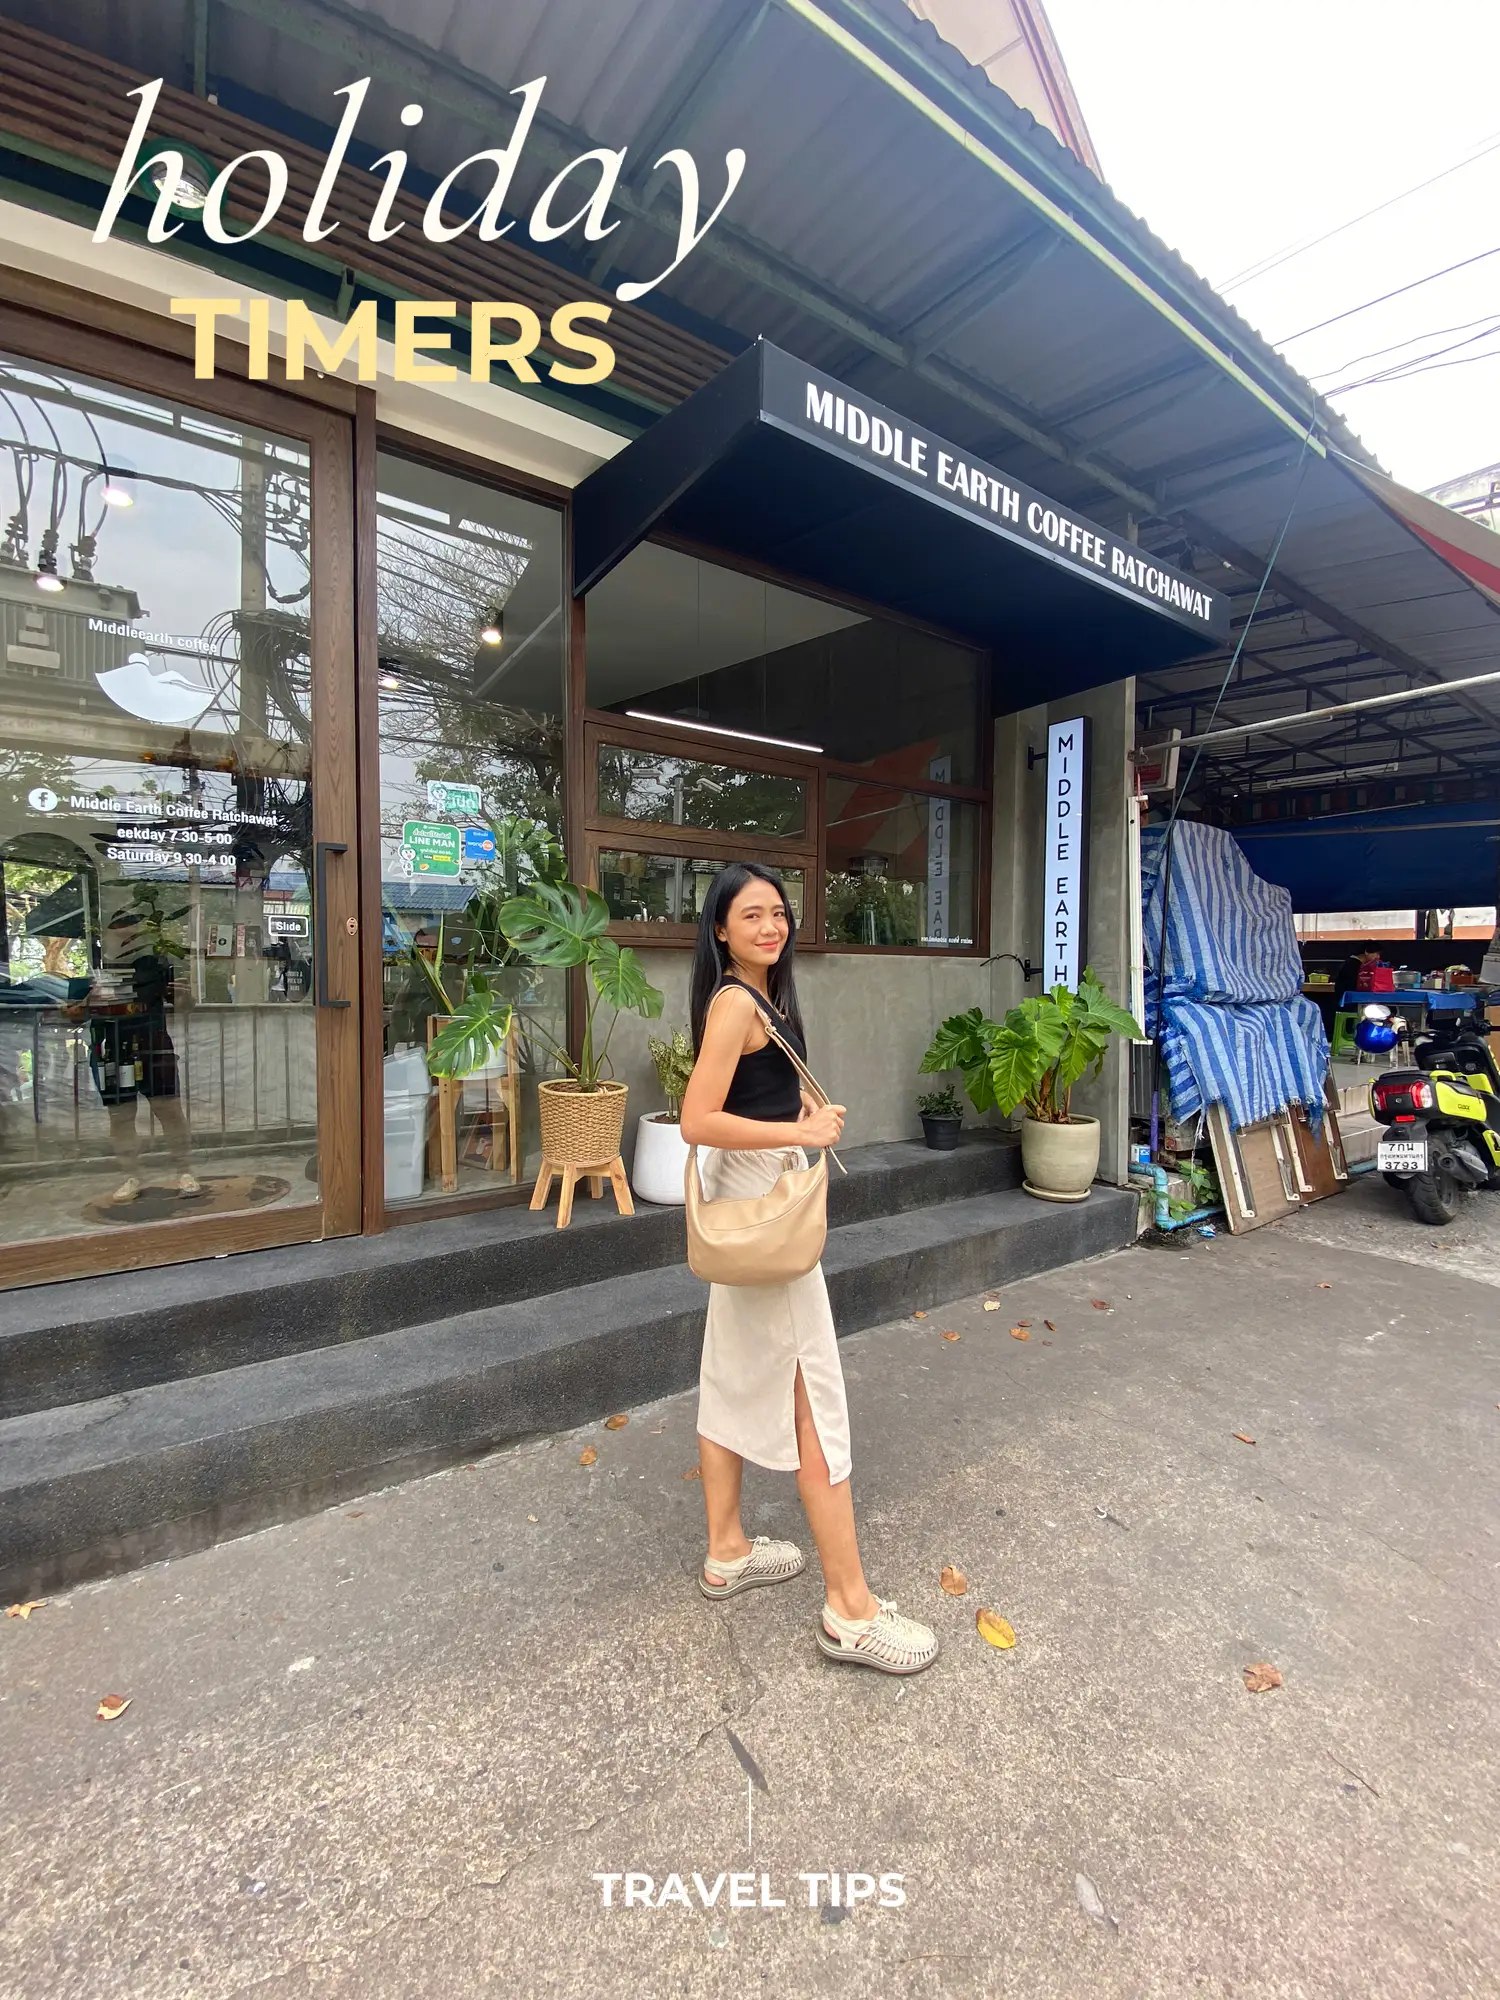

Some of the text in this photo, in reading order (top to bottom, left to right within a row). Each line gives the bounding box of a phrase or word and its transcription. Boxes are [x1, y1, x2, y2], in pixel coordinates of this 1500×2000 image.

[806, 381, 1213, 621] MIDDLE EARTH COFFEE RATCHAWAT
[88, 618, 218, 653] Middleearth coffee
[70, 795, 121, 812] Middle
[126, 801, 162, 816] Earth
[166, 804, 209, 819] Coffee
[213, 809, 278, 826] Ratchawat
[409, 836, 456, 848] LINE MAN
[106, 847, 170, 865] Saturday
[1054, 733, 1074, 982] MIDDLE EARTH
[275, 921, 301, 932] Slide
[1385, 1161, 1418, 1170] 3793
